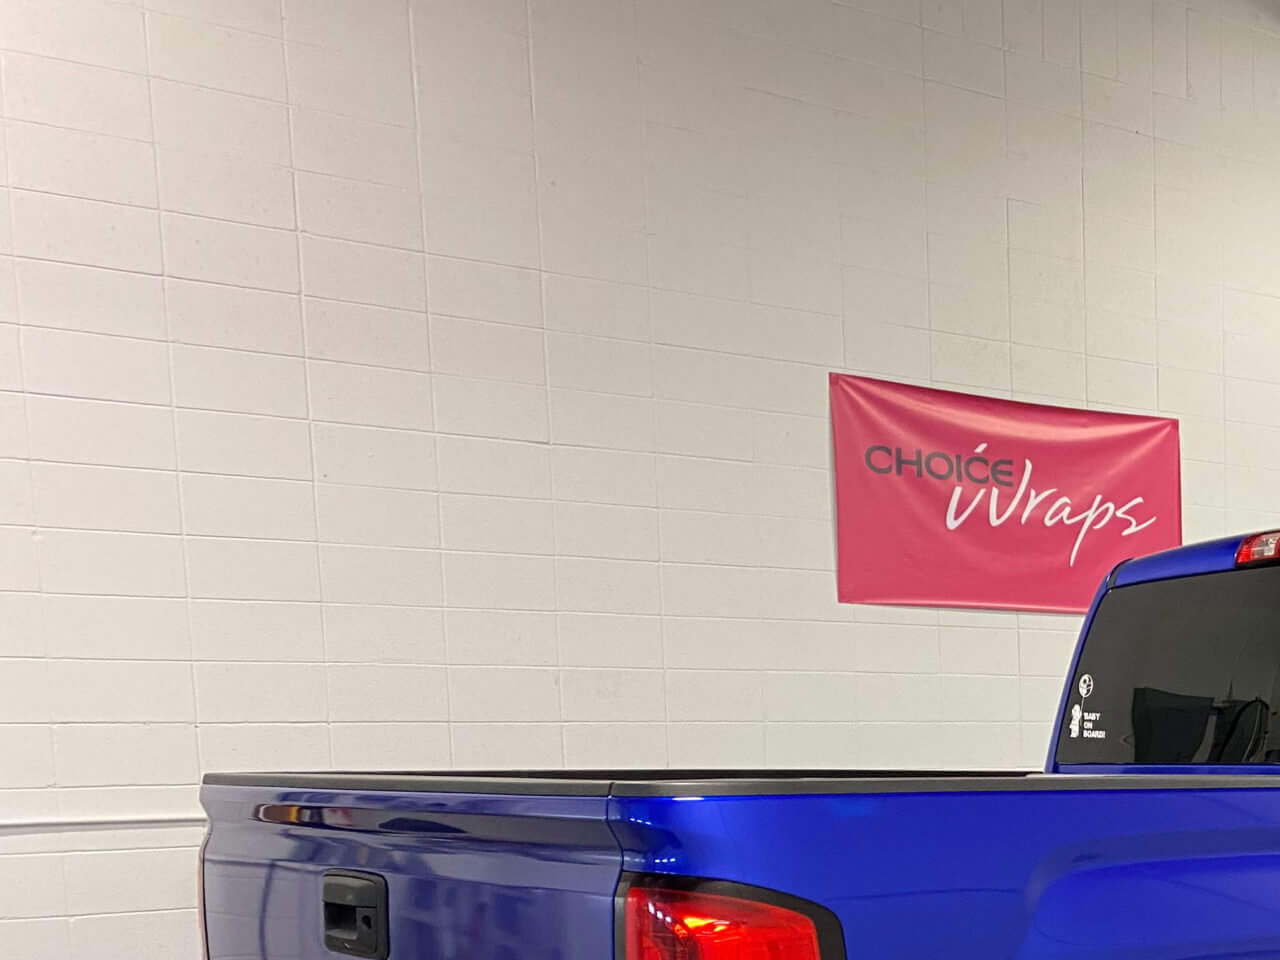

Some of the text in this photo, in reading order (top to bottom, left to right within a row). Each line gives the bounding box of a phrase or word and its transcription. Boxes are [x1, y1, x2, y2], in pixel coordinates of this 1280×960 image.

[864, 444, 1014, 488] CHOICE
[945, 458, 1157, 567] Wraps
[1083, 721, 1093, 730] ON
